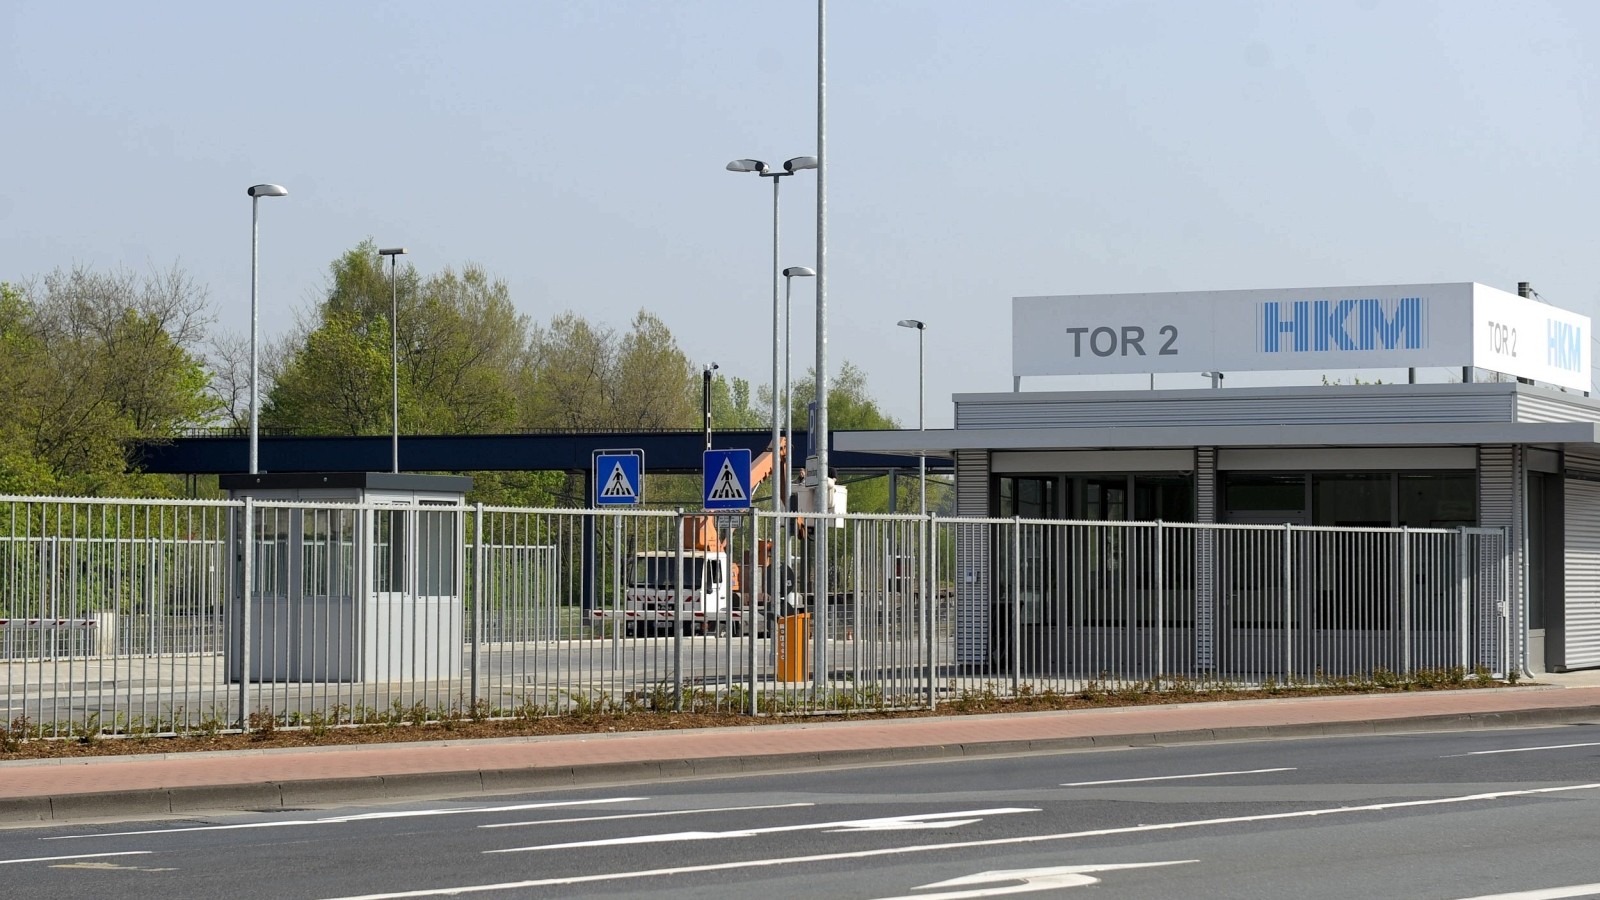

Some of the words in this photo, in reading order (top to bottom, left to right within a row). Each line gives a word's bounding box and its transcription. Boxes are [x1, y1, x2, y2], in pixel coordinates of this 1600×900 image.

[1066, 326, 1146, 357] TOR
[1158, 325, 1179, 356] 2
[1261, 298, 1424, 353] HKM
[1488, 320, 1509, 356] TOR
[1511, 327, 1517, 358] 2
[1547, 318, 1581, 373] HKM
